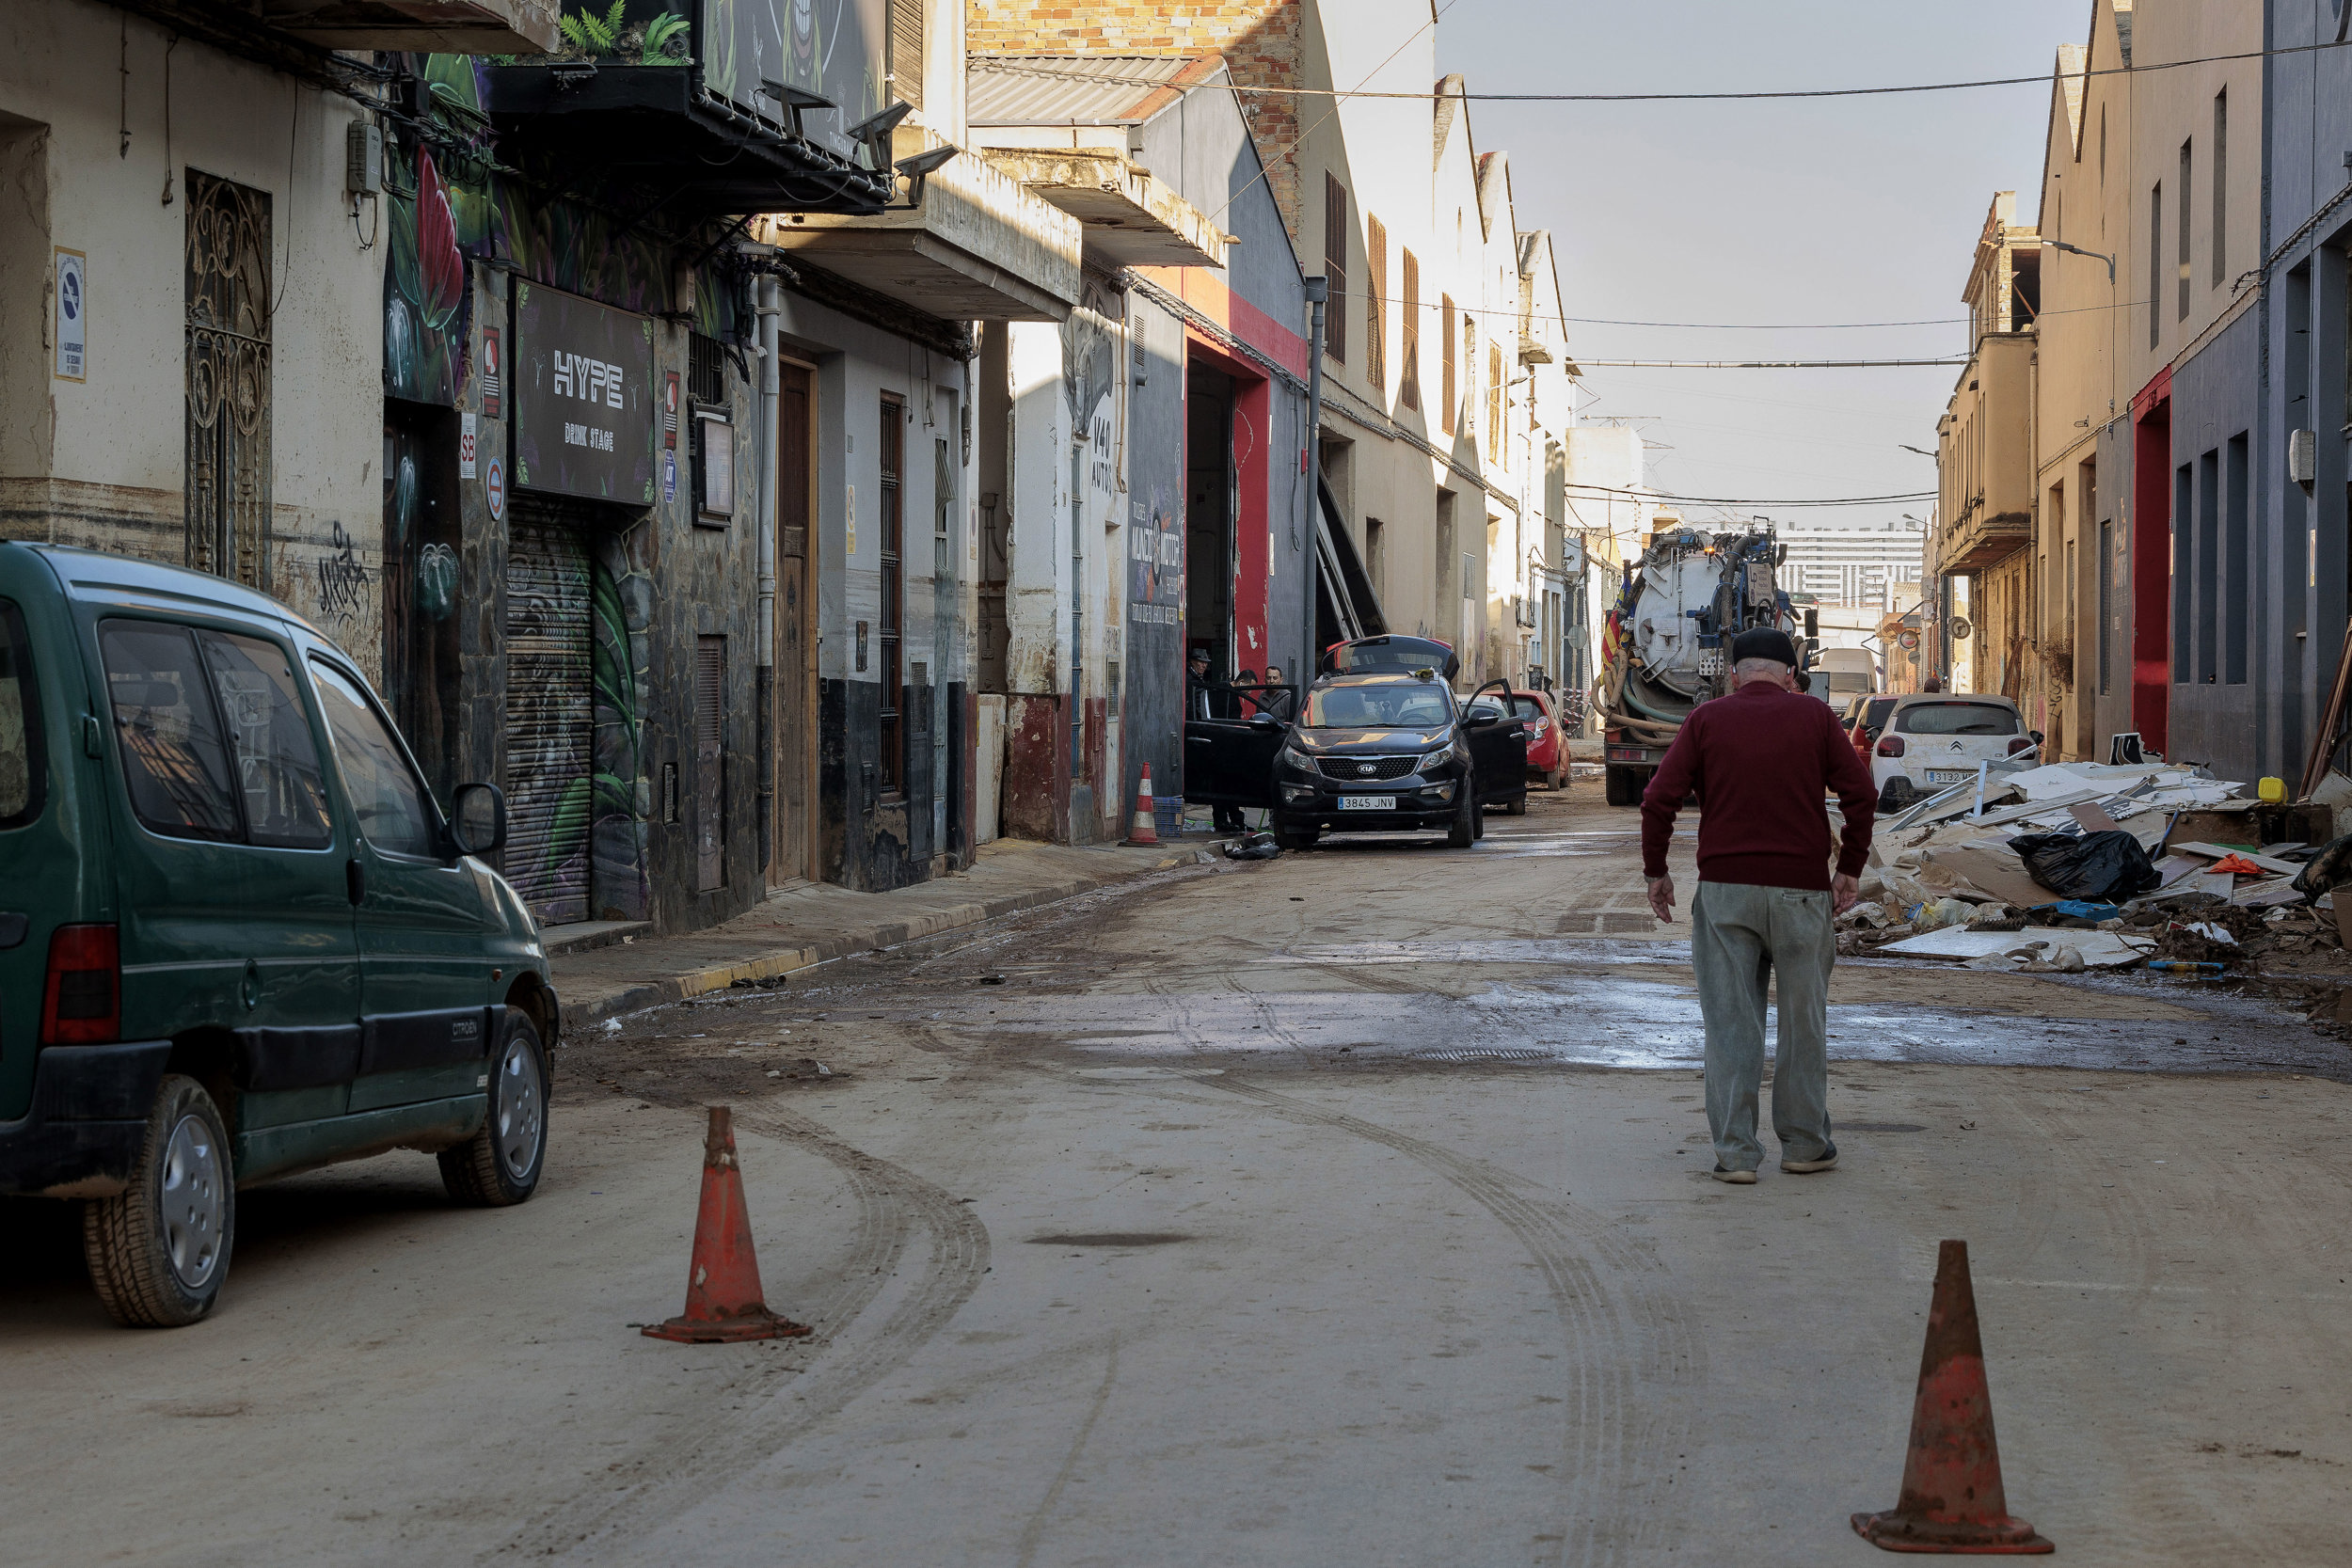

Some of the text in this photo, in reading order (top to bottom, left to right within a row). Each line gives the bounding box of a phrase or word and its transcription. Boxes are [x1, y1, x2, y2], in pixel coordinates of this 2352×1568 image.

[554, 349, 624, 410] HYPE
[462, 434, 475, 462] SB
[564, 421, 613, 452] DRINK STAGE
[1094, 416, 1110, 459] V40
[1091, 461, 1112, 498] AUTOS
[1345, 799, 1393, 808] 3845 JNV
